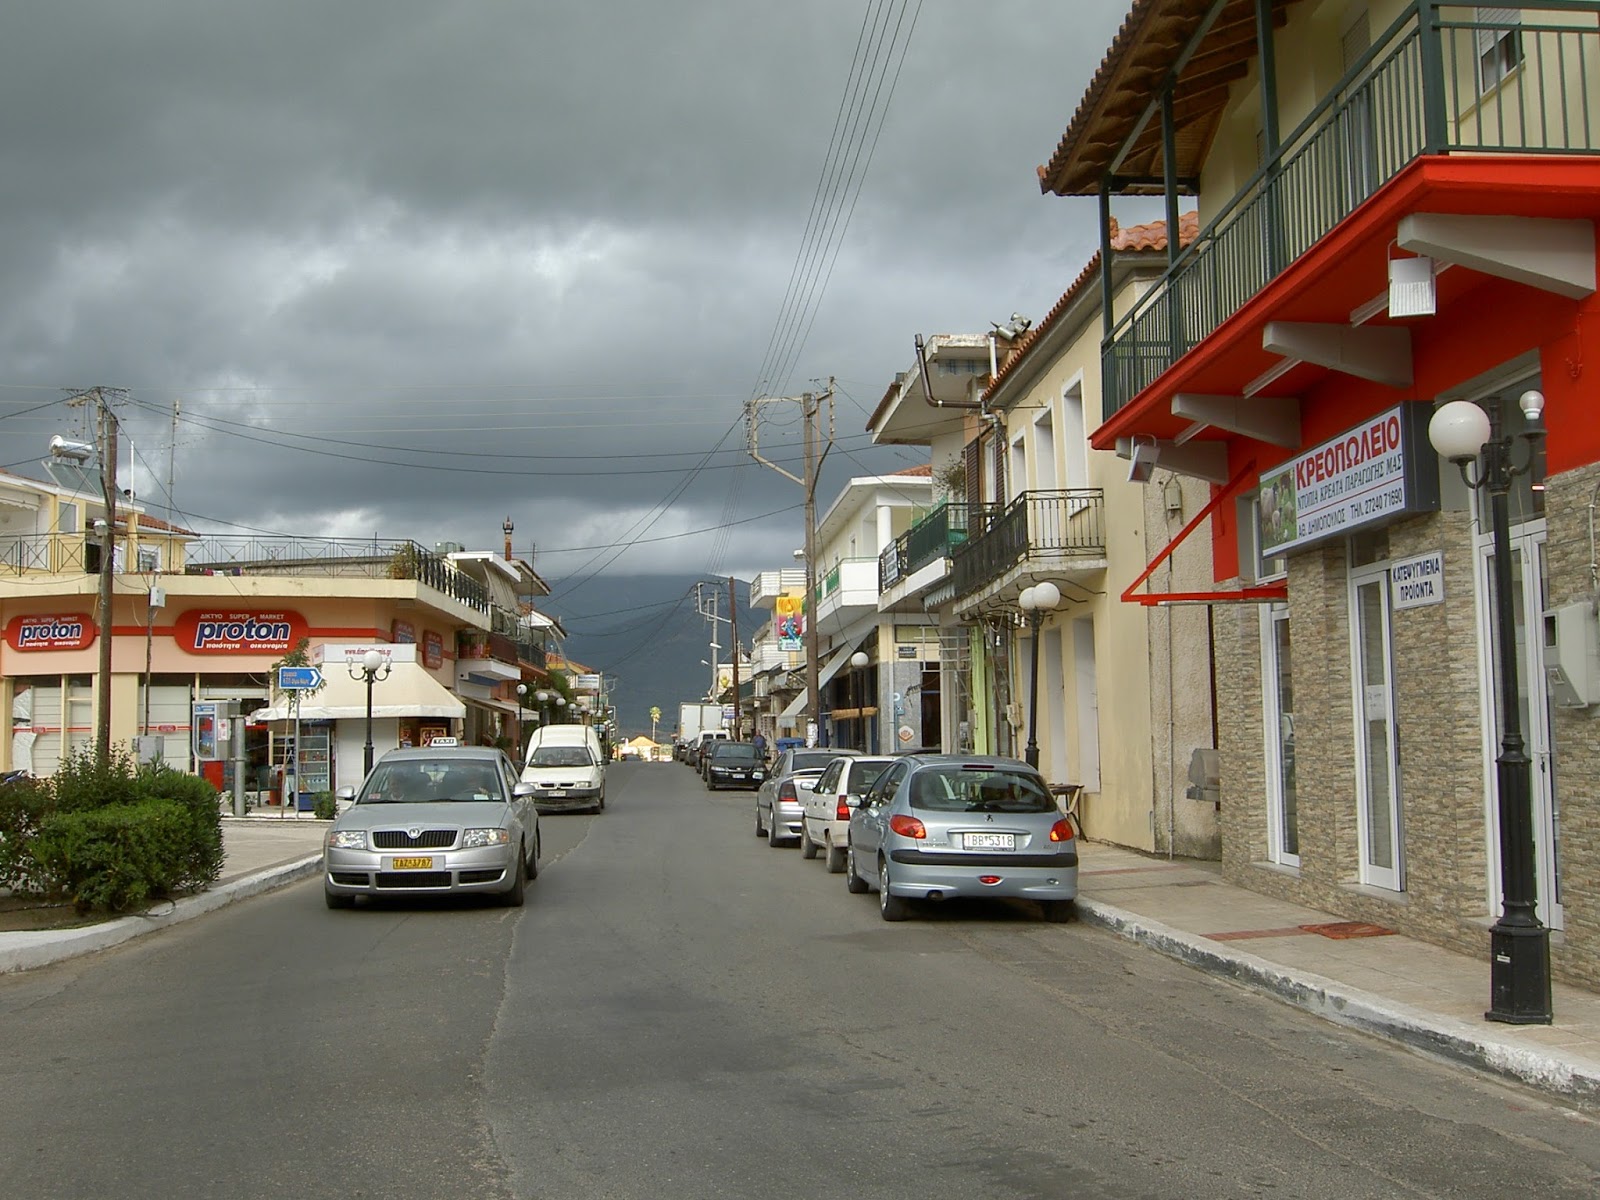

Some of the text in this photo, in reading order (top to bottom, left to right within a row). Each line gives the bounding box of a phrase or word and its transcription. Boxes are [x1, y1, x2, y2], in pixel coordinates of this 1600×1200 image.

[1296, 415, 1400, 491] ΚΡΕΟΠΩΛΕΙΟ
[1320, 481, 1344, 501] ΚΡΕΑΤΑ
[1345, 461, 1384, 492] ΠΑΡΑΓΩΓΗΣ
[1386, 453, 1402, 475] ΜΑΣ
[1308, 508, 1346, 535] ΔΗΜΟΠΟΥΛΟΣ
[1365, 495, 1383, 515] 27240
[1393, 558, 1440, 583] ΚΑΤΕΨΥΓΜΕΝΑ
[18, 621, 82, 647] proton
[194, 617, 291, 648] proton
[206, 642, 240, 650] ποιότητα
[250, 642, 288, 650] οικονομία
